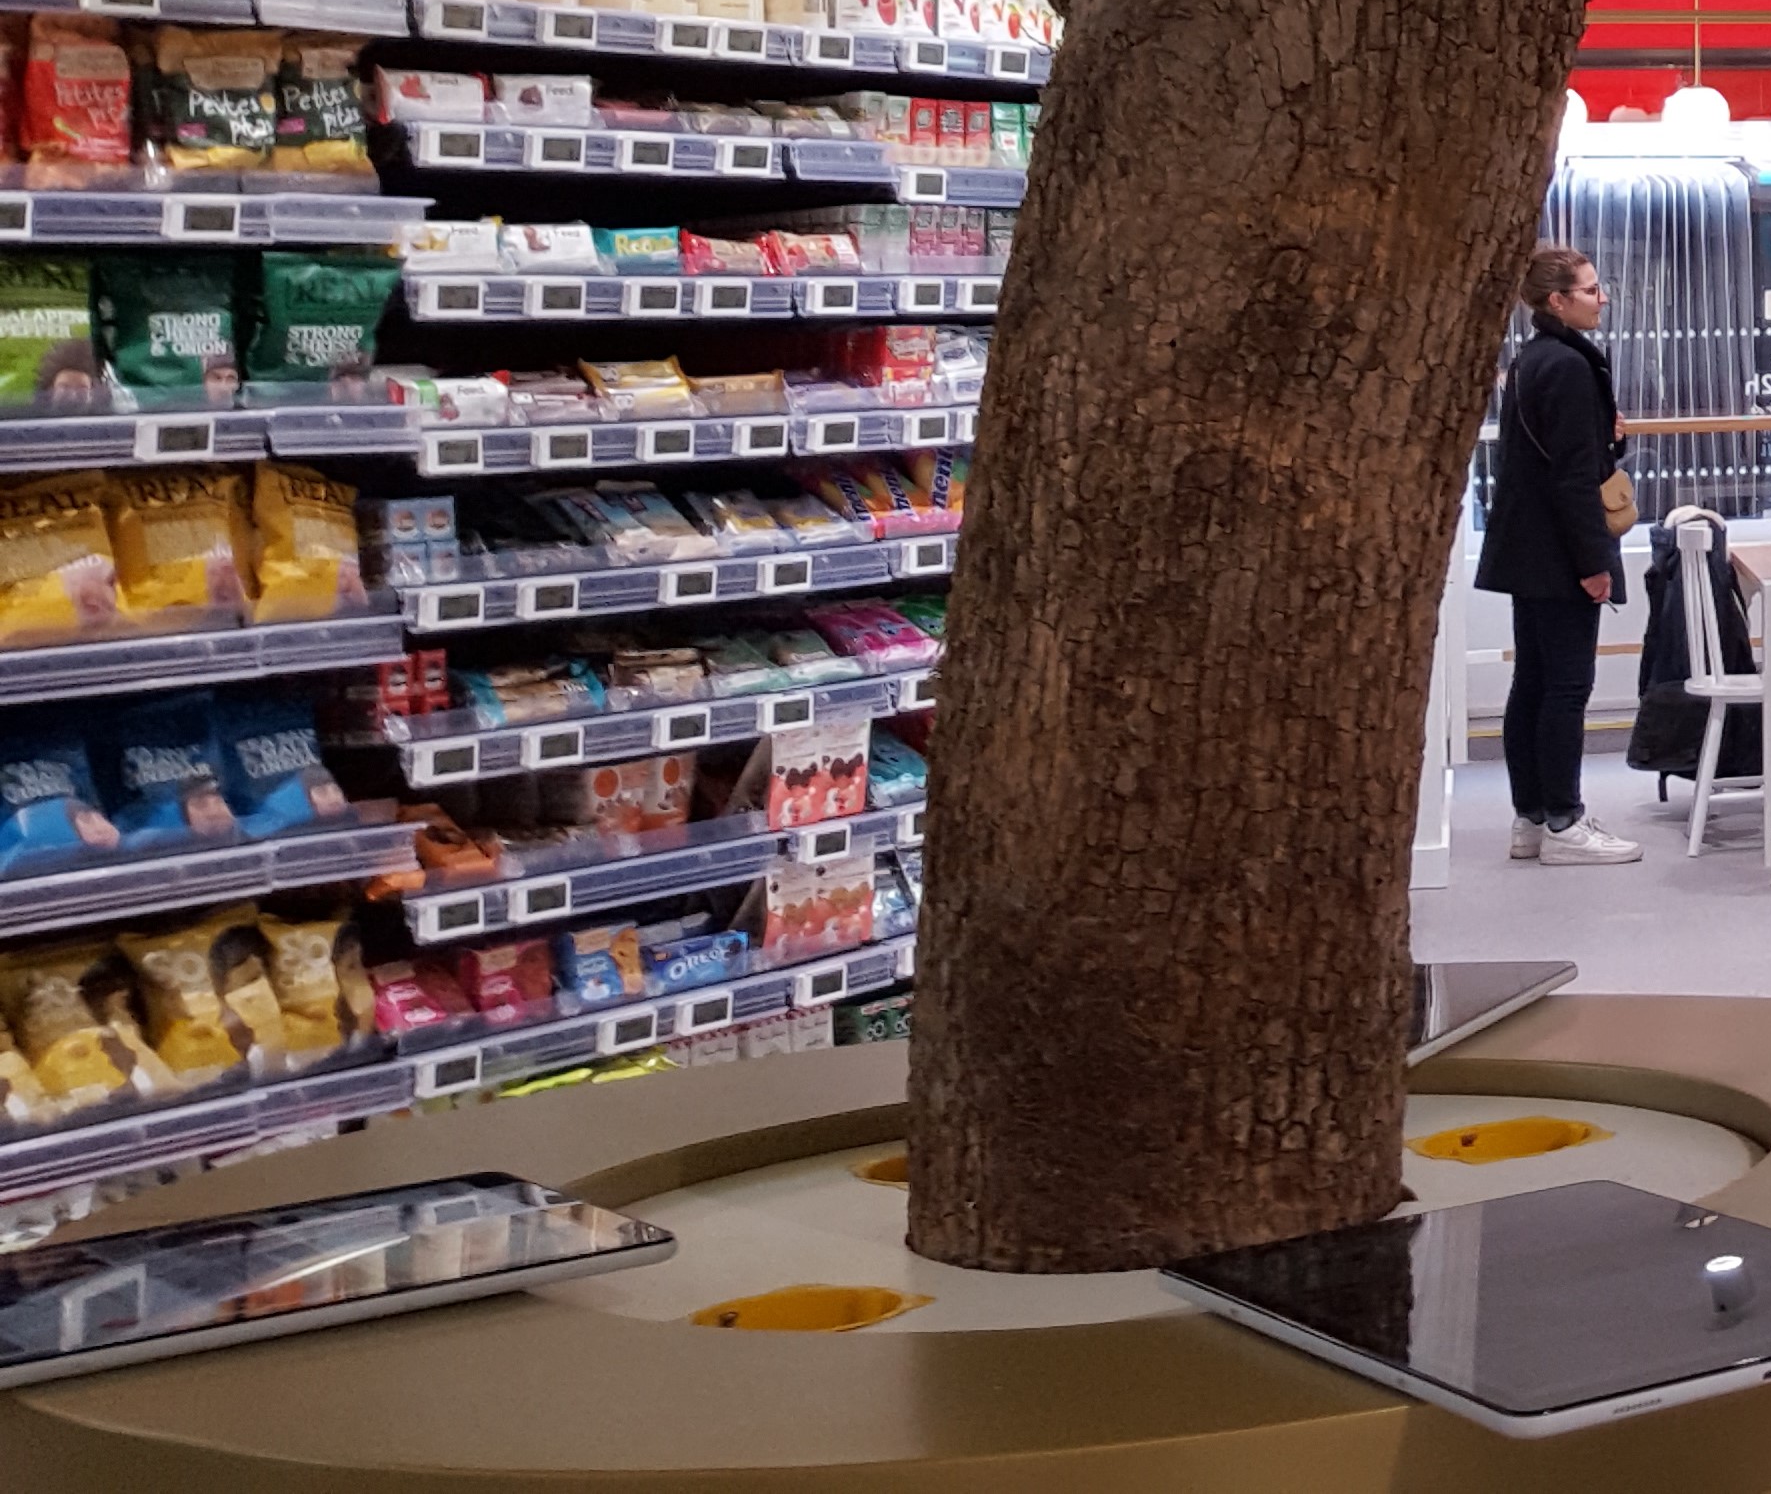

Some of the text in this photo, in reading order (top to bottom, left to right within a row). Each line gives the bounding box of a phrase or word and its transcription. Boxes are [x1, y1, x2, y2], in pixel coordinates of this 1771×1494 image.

[150, 312, 221, 327] STRONG
[287, 325, 363, 340] STRONG
[172, 340, 227, 354] ONION
